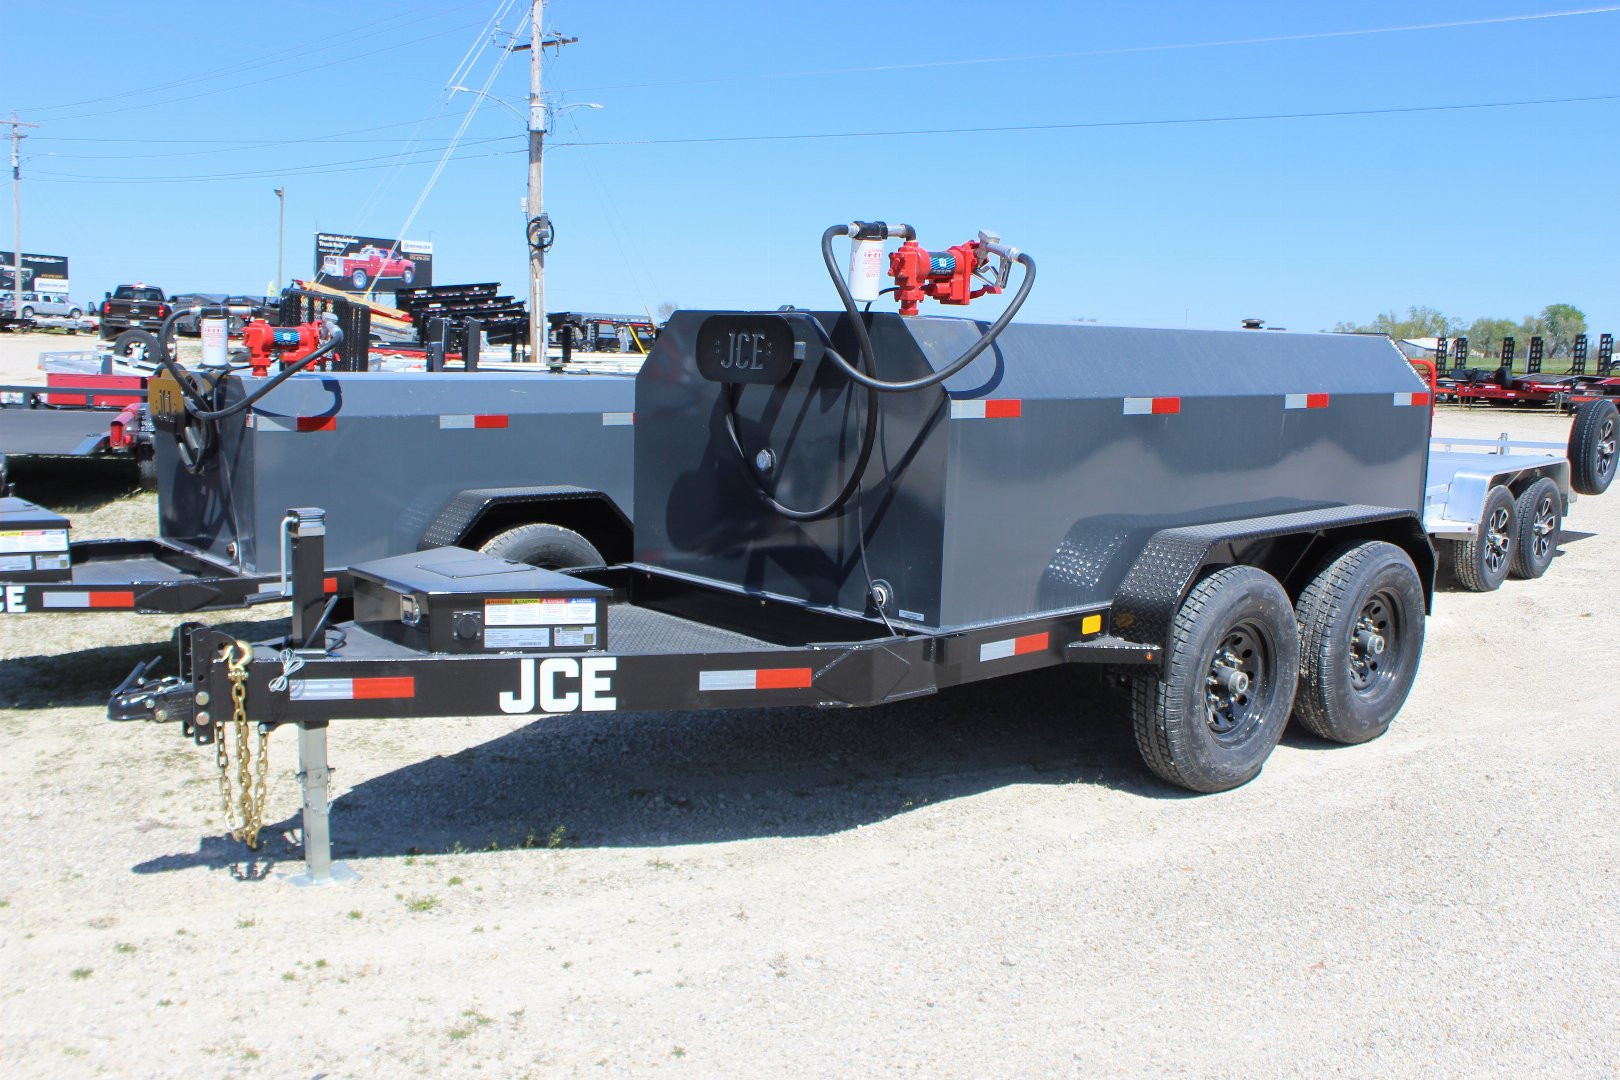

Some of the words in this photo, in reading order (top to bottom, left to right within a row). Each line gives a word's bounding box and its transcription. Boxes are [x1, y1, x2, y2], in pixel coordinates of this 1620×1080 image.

[720, 331, 765, 370] JCE
[0, 585, 27, 613] E
[499, 657, 617, 714] JCE
